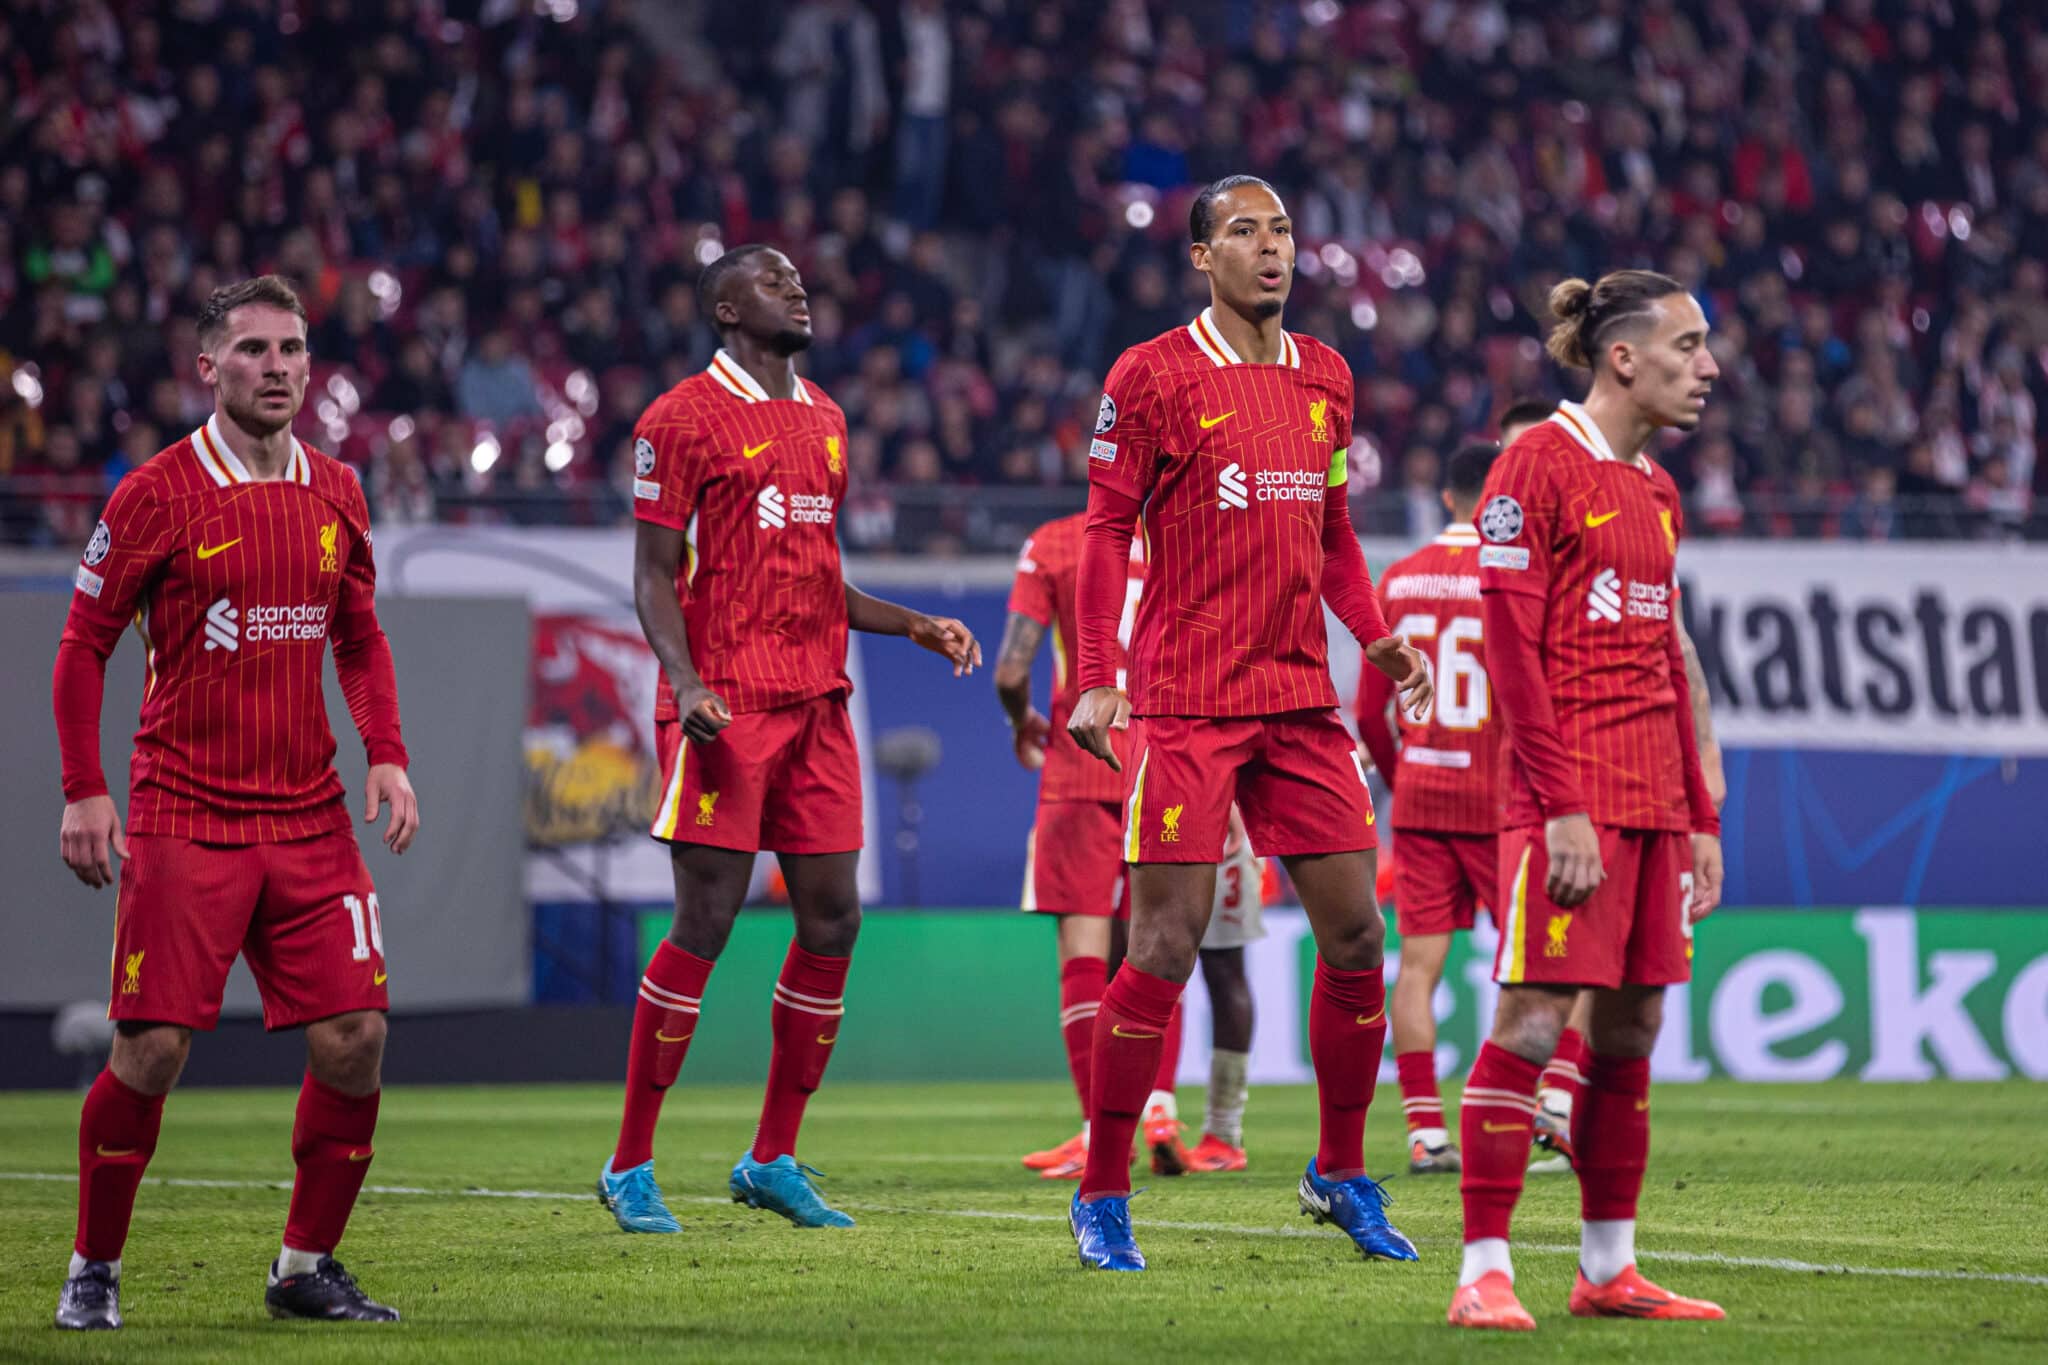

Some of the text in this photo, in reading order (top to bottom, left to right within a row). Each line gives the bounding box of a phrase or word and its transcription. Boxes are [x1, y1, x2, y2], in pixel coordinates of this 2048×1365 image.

[1255, 469, 1325, 485] standard
[1256, 485, 1324, 502] chartered
[790, 508, 833, 524] charte
[247, 603, 328, 623] standard
[1627, 600, 1668, 620] charte
[246, 621, 326, 641] charteed
[1393, 614, 1487, 728] 66
[343, 892, 384, 960] 10
